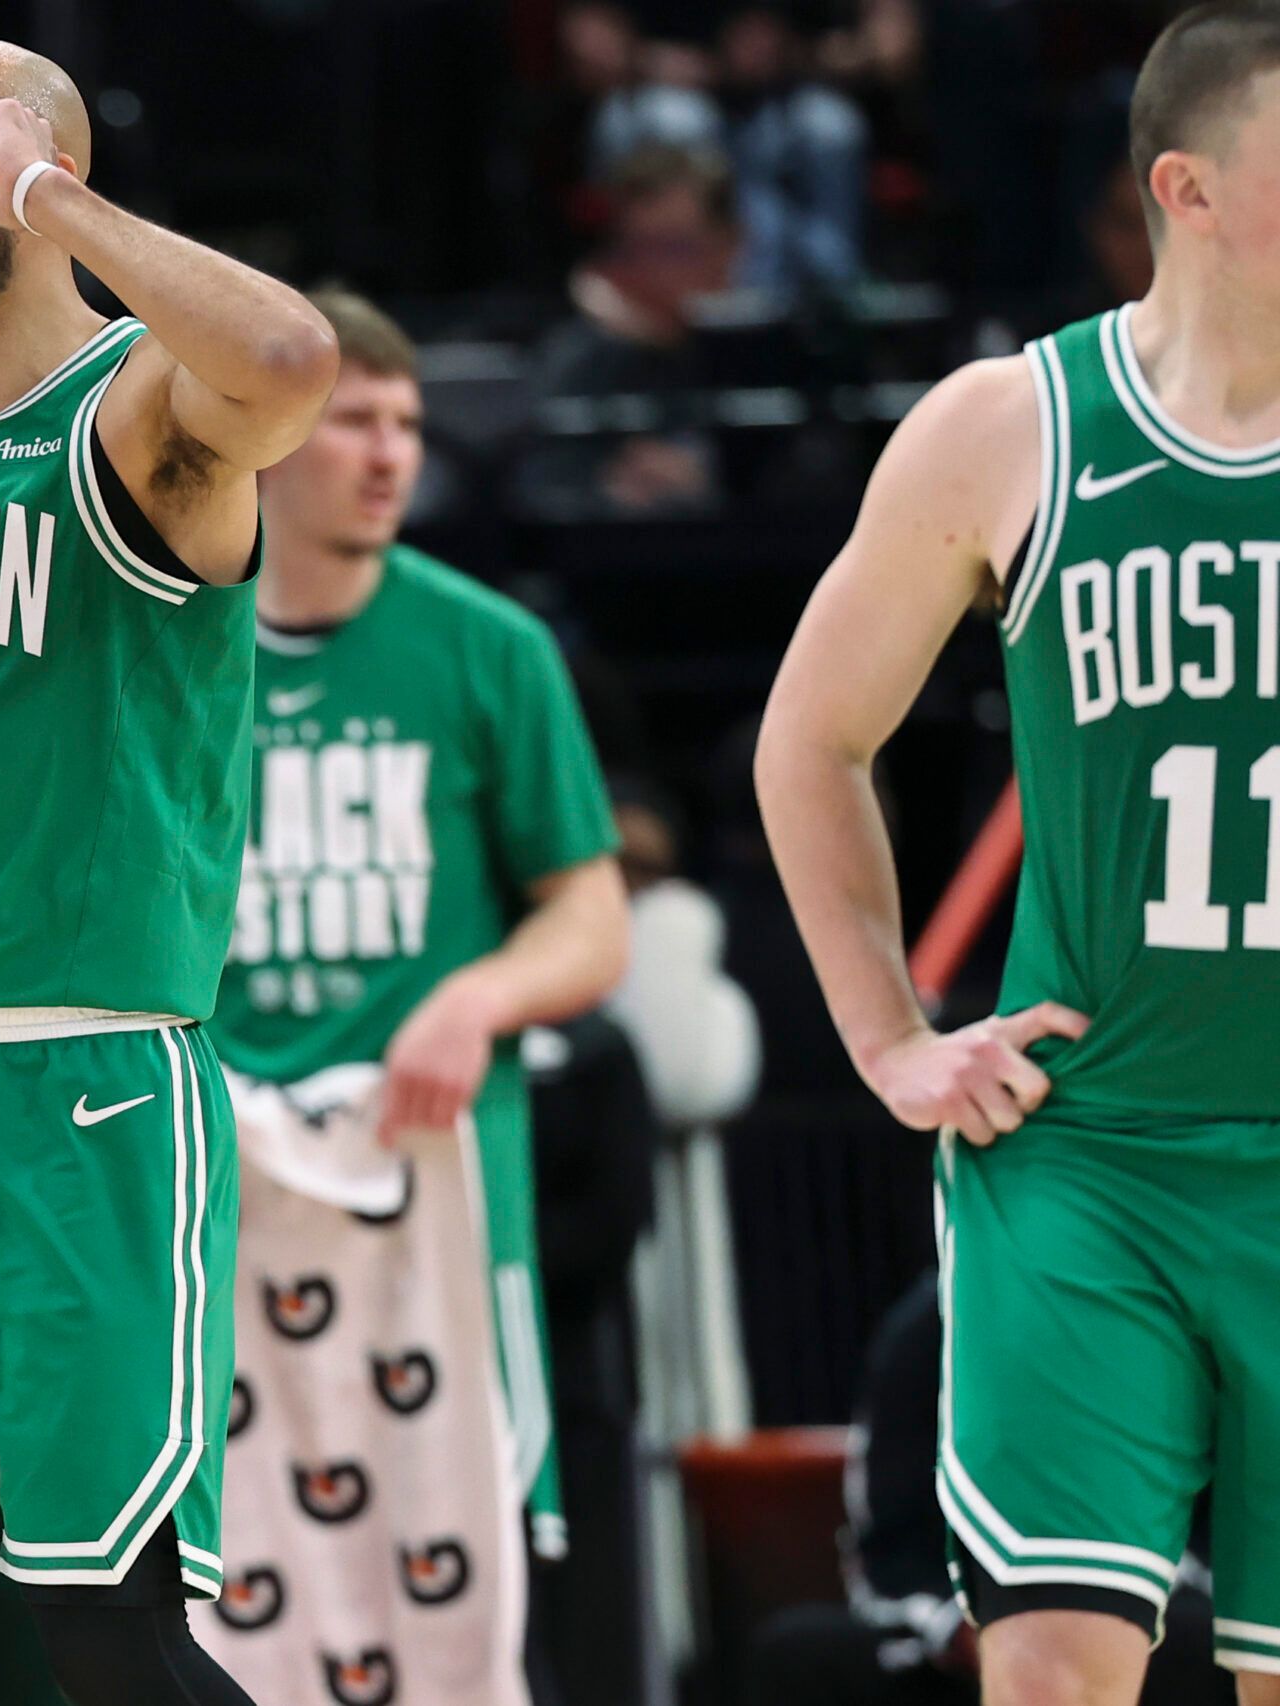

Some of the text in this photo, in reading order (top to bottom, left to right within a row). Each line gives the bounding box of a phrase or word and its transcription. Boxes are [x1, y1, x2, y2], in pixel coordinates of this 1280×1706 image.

[1060, 540, 1280, 727] BOST
[243, 741, 434, 872] ACK
[229, 873, 432, 964] STORY
